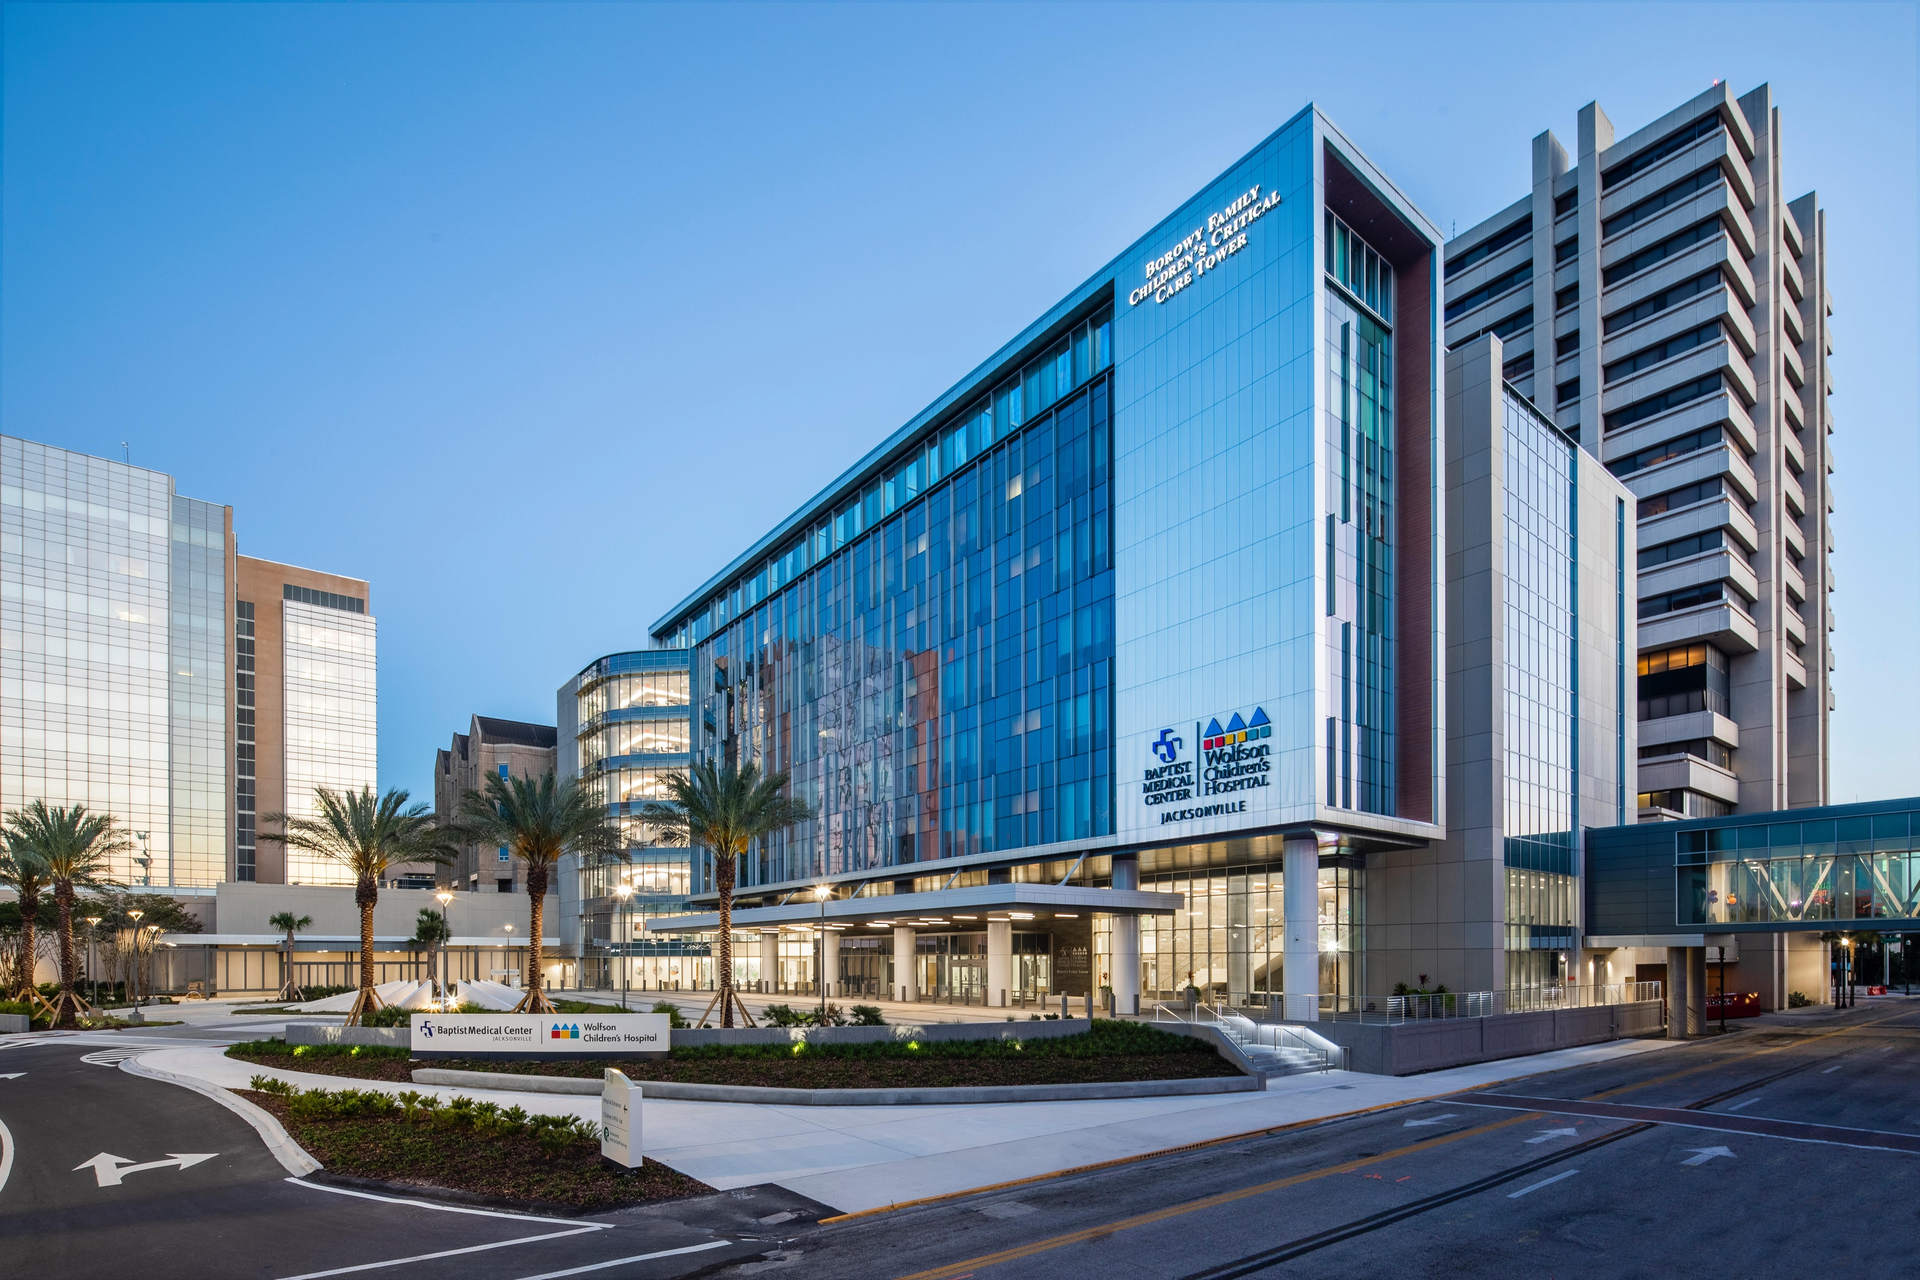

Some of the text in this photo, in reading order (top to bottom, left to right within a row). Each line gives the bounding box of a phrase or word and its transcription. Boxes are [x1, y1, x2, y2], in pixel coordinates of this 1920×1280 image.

[1210, 191, 1282, 248] CRITICAL
[1145, 184, 1261, 280] BOROWY FAMILY
[1155, 233, 1249, 304] CARE TOWER
[1204, 743, 1271, 767] Wolfson
[1144, 761, 1192, 780] BAPTIST
[1203, 757, 1271, 782] Children's
[1142, 774, 1194, 793] MEDICAL
[1204, 774, 1270, 796] HOSPITAL
[1144, 788, 1192, 806] CENTER
[1160, 800, 1247, 825] JACKSONVILLE
[437, 1025, 533, 1036] Baptist Medical Center
[583, 1022, 617, 1032] Wolfson
[583, 1033, 657, 1044] Children's Hospital
